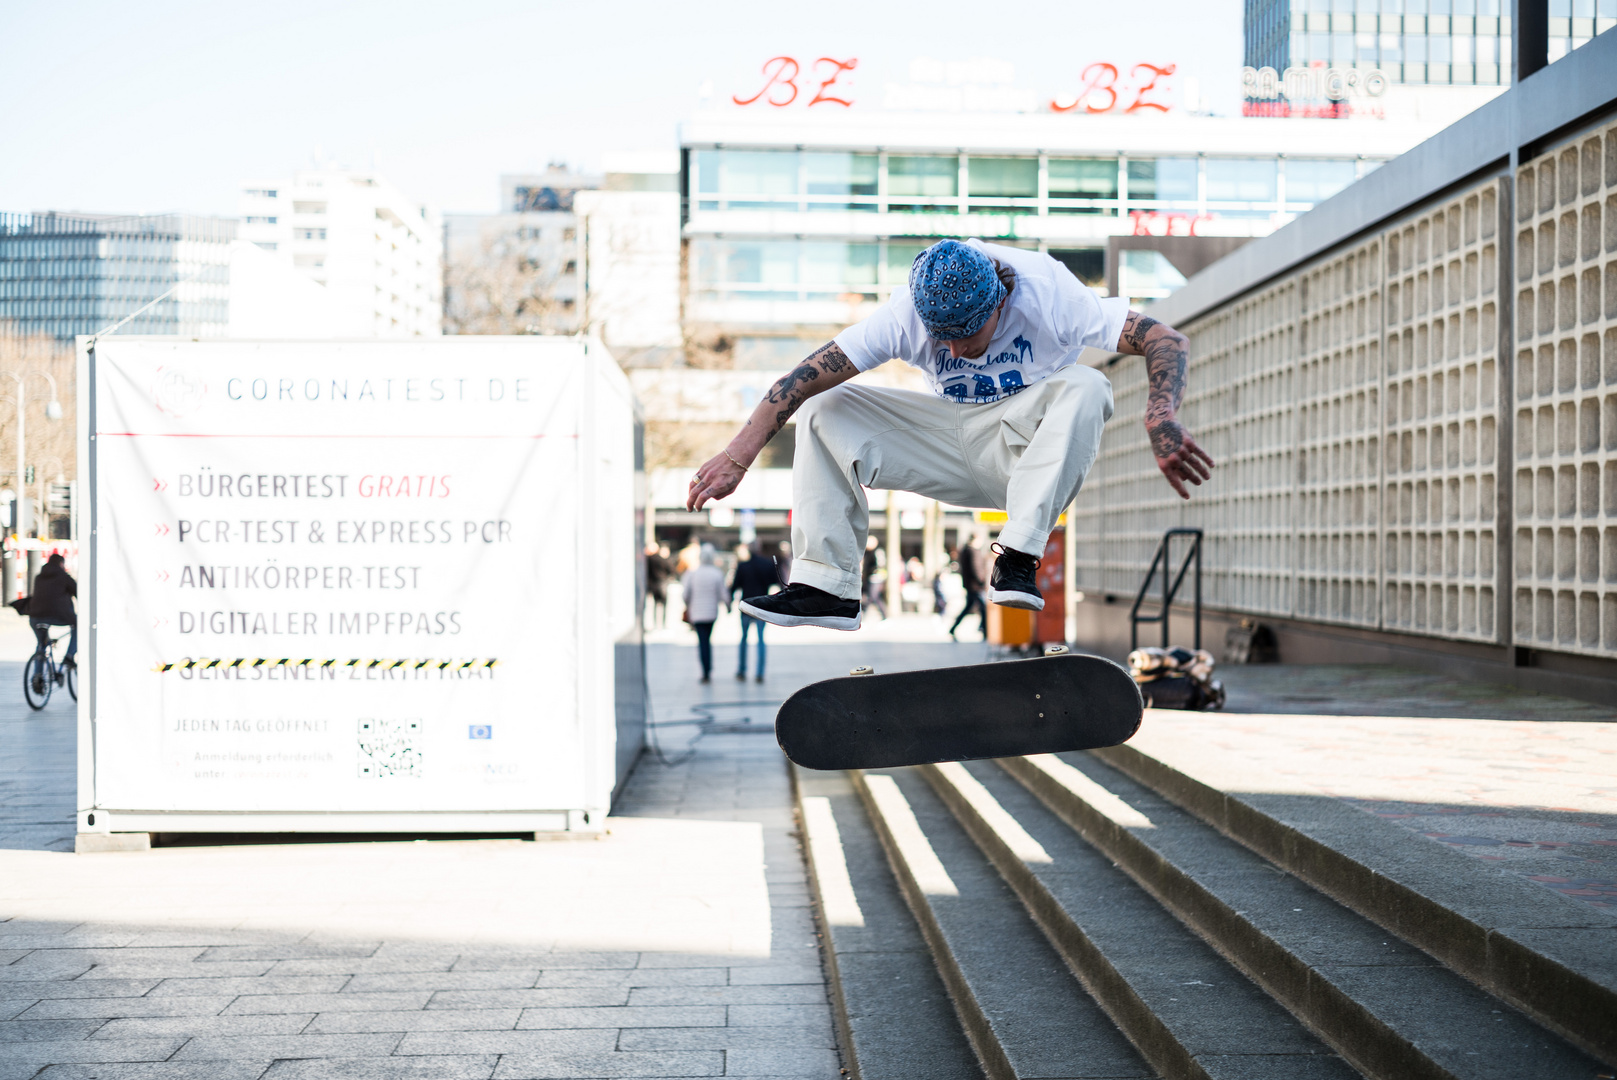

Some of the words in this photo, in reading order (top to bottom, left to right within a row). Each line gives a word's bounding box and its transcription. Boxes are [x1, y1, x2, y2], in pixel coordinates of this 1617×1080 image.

[178, 466, 349, 498] BÜRGERTEST
[357, 473, 452, 499] GRATIS
[177, 519, 300, 544] PCR-TEST
[307, 520, 325, 544] &
[336, 519, 453, 545] EXPRESS
[463, 519, 512, 545] PCR
[178, 559, 422, 590] ANTIKÖRPER-TEST
[178, 610, 318, 636] DIGITALER
[328, 610, 462, 636] IMPFPASS
[173, 718, 220, 732] JEDEN
[225, 718, 251, 732] TAG
[255, 715, 329, 732] GEÖFFNET
[194, 751, 262, 764] Anmeldung
[265, 751, 334, 763] erforderlich
[194, 769, 226, 779] unter
